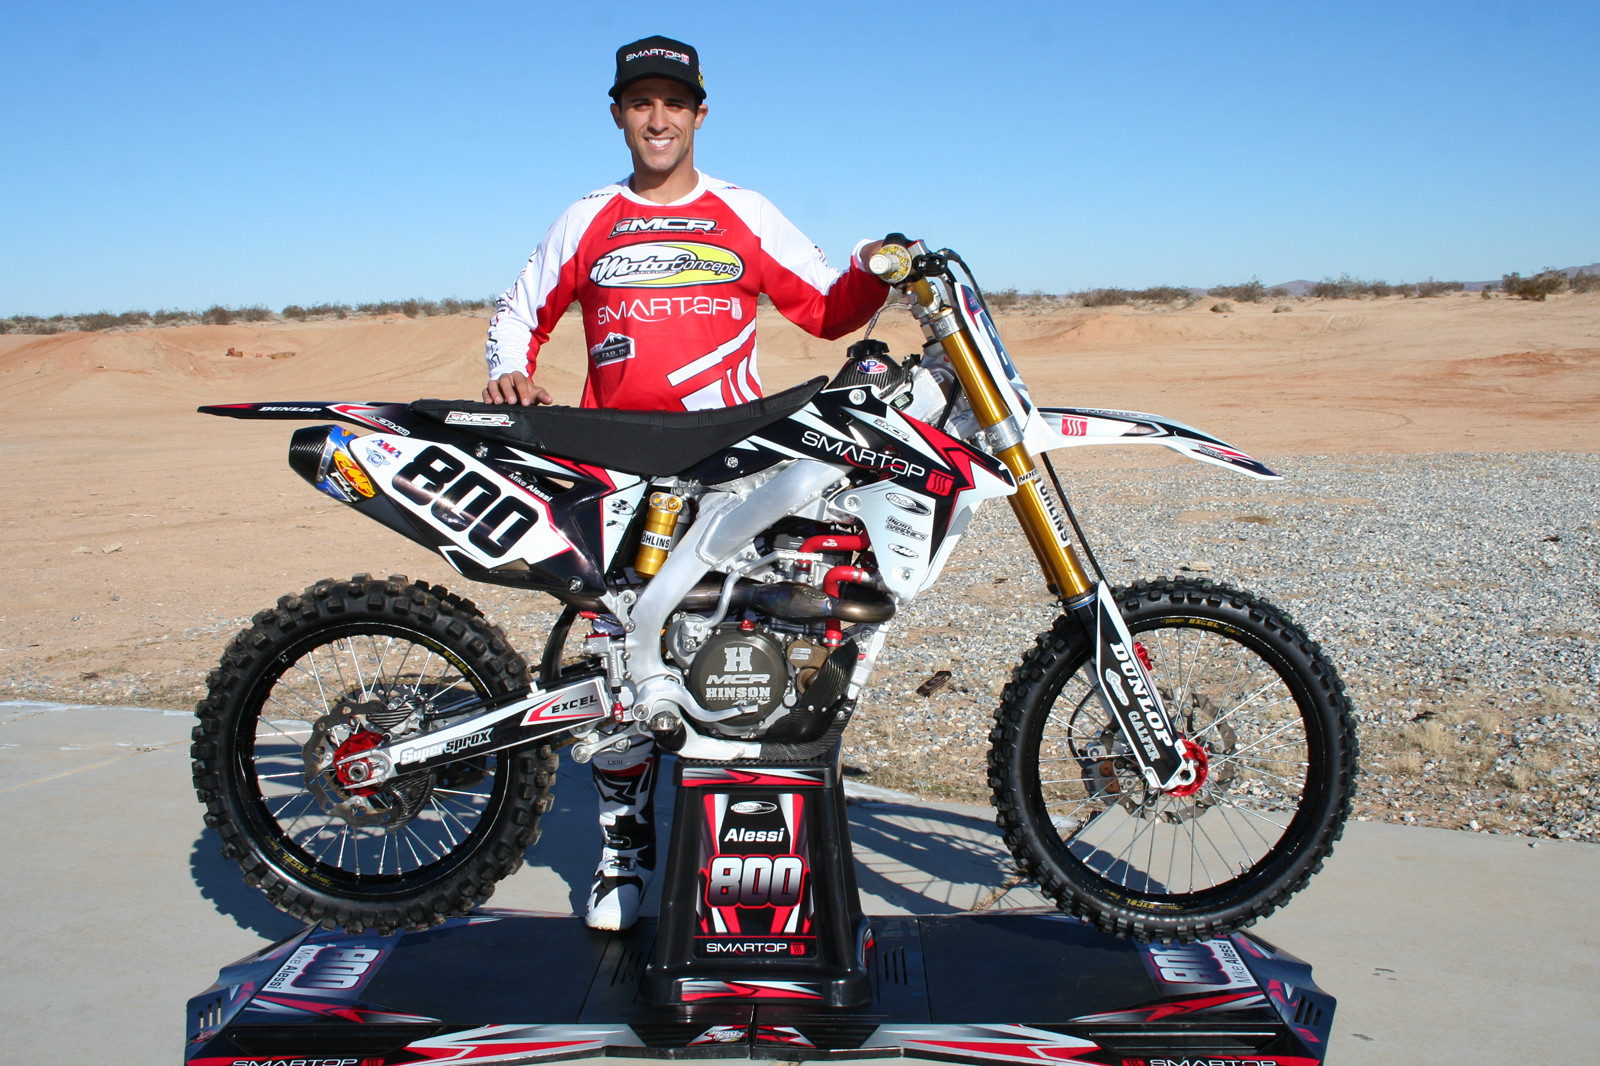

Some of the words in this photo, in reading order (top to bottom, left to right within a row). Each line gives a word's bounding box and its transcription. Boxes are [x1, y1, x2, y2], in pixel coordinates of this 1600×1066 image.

[625, 48, 682, 62] SMARTOP
[597, 296, 731, 325] SMARTOP
[370, 439, 402, 458] AMA
[801, 430, 925, 478] SMARTOP
[508, 472, 526, 486] Mike
[526, 484, 553, 502] Alessi
[392, 445, 539, 559] 800
[1188, 618, 1219, 629] EXCEL
[723, 646, 753, 672] H
[706, 673, 771, 685] MCR
[705, 687, 771, 698] HINSON
[1109, 642, 1173, 747] DUNLOP
[551, 694, 599, 714] EXCEL
[723, 827, 785, 842] Alessi
[707, 855, 805, 908] 800
[289, 947, 315, 964] Mike
[706, 942, 788, 953] SMARTOP
[1212, 942, 1242, 965] Alessi
[267, 964, 299, 990] Alessi
[291, 946, 384, 990] 800
[1232, 965, 1252, 983] Mike
